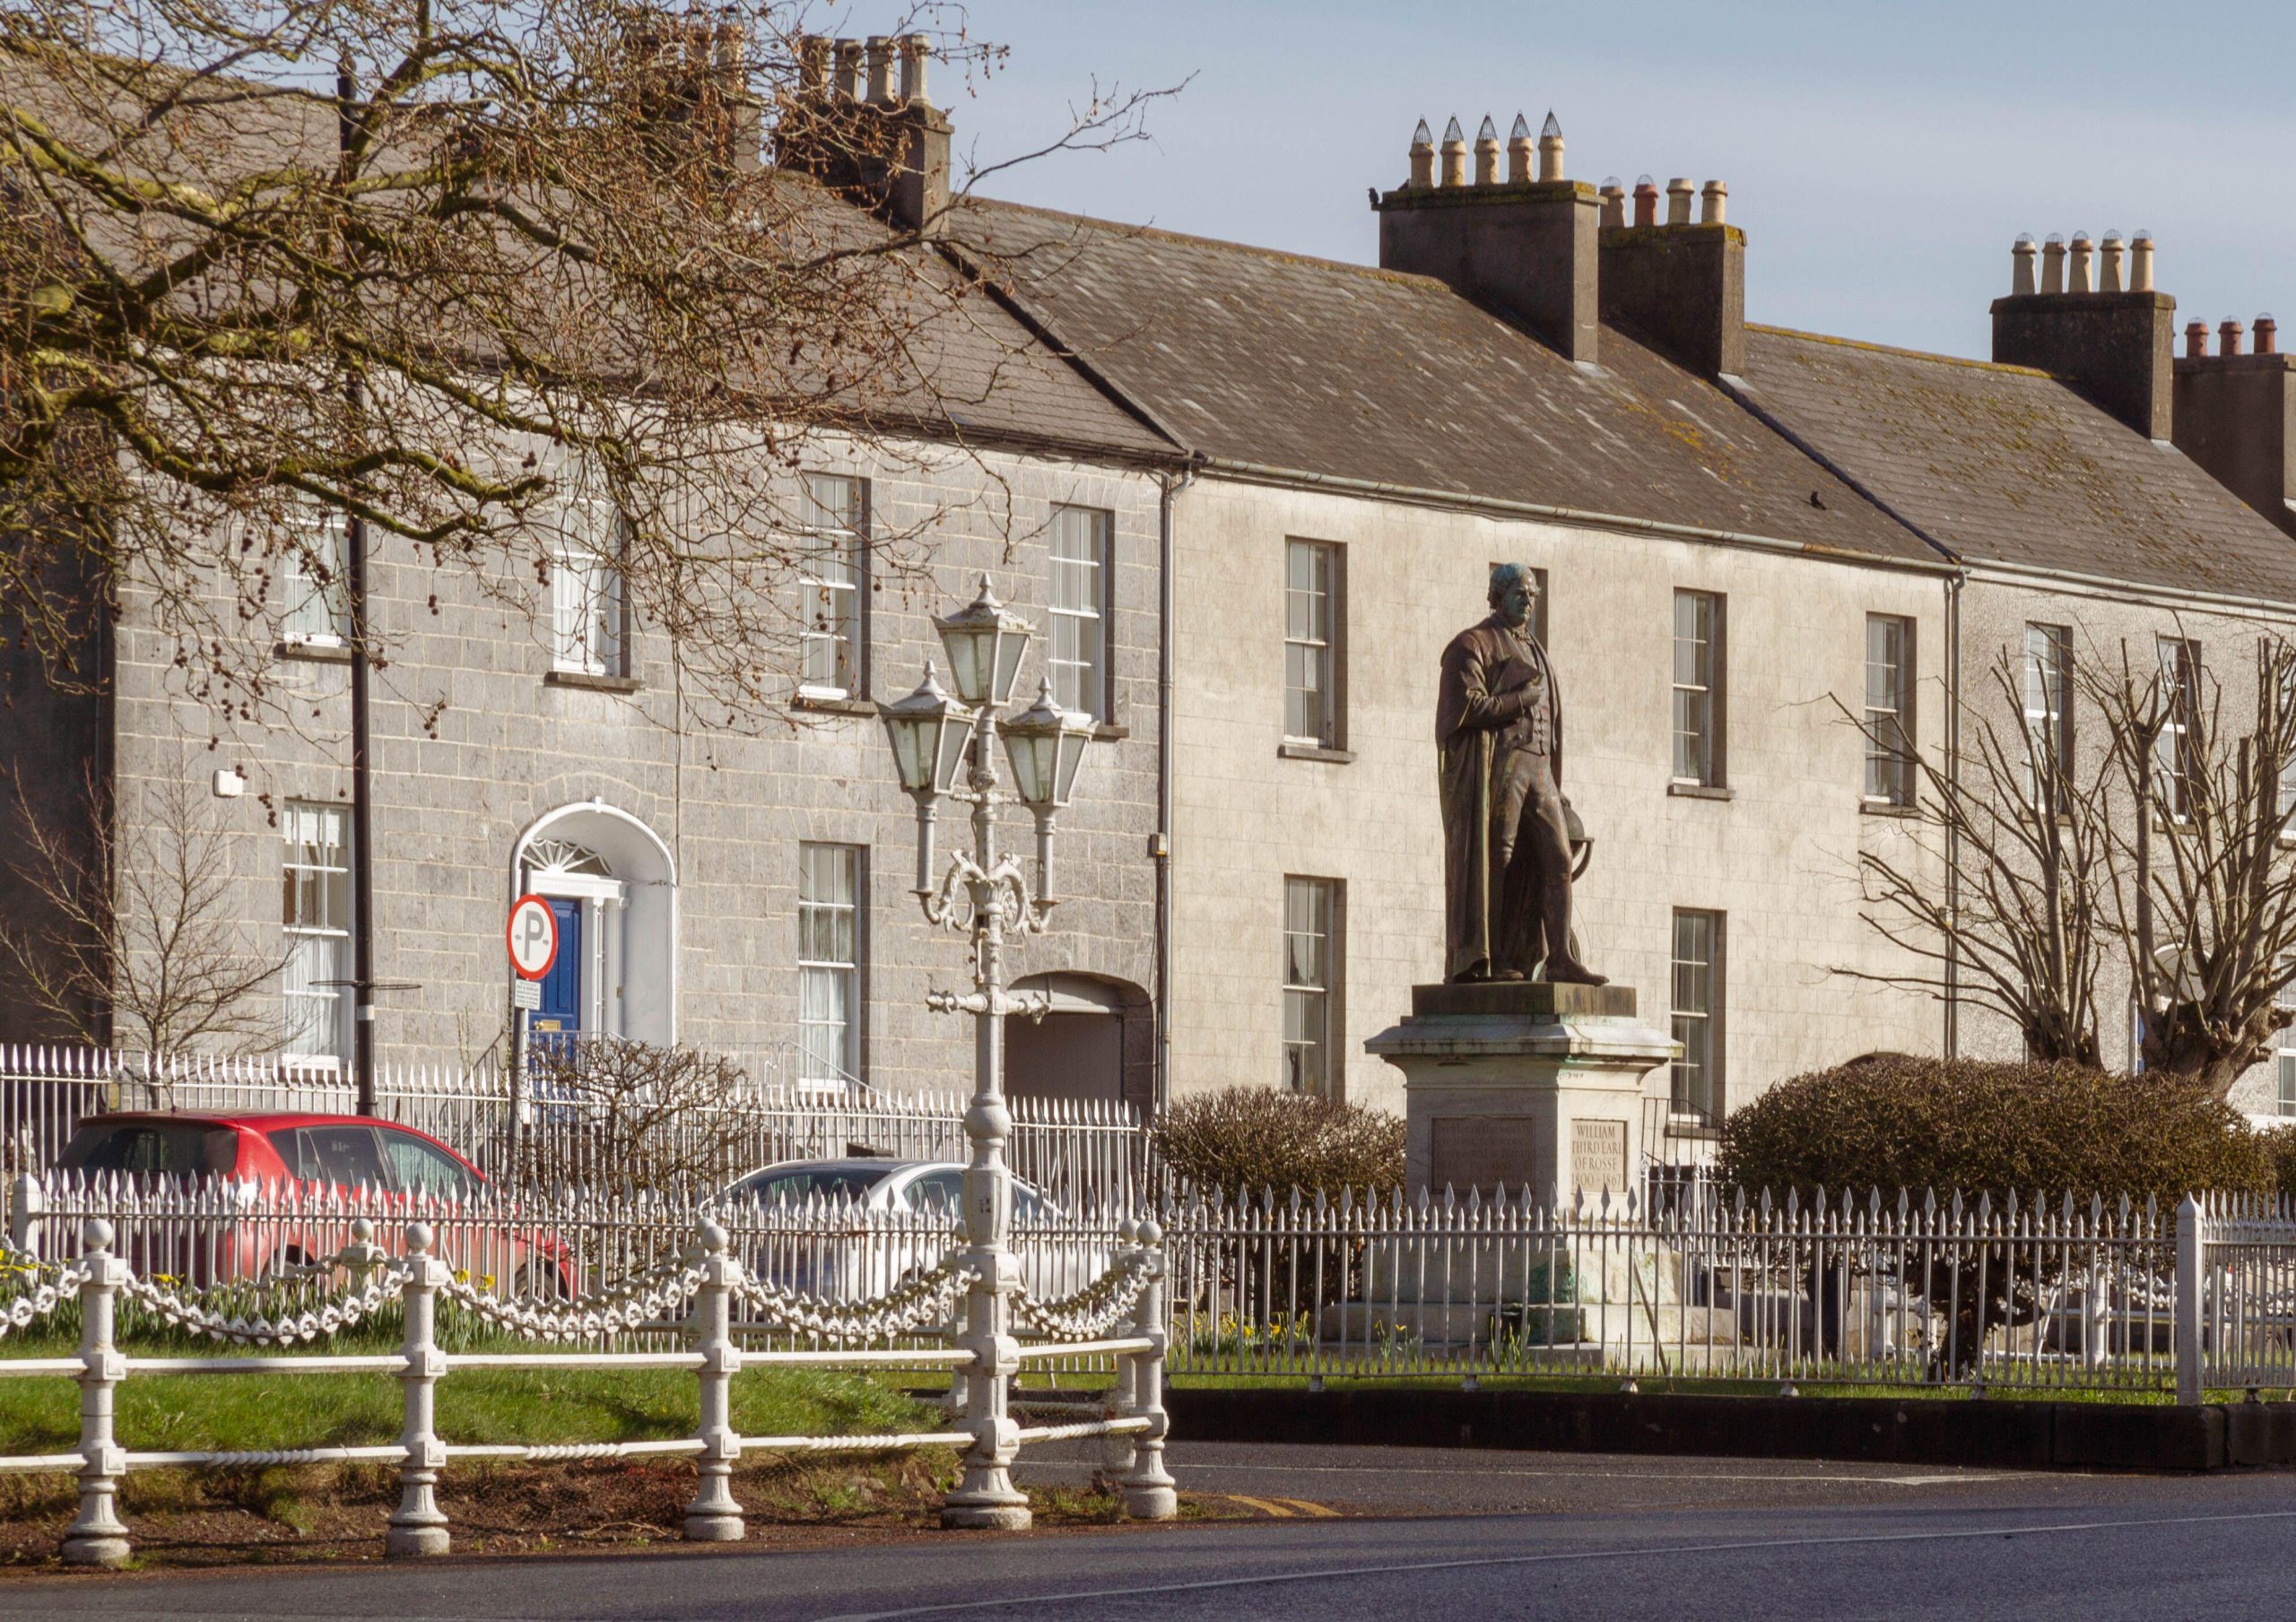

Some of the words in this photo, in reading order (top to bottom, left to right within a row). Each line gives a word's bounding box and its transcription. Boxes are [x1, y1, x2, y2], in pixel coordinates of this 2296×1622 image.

[524, 910, 544, 961] P
[1577, 1124, 1615, 1139] WILLIAM
[1572, 1141, 1600, 1154] THIRD
[1602, 1141, 1622, 1155] EARL
[1574, 1157, 1587, 1170] OF
[1588, 1157, 1617, 1170] ROSSE
[1571, 1173, 1595, 1186] 1800
[1603, 1173, 1622, 1187] 1867
